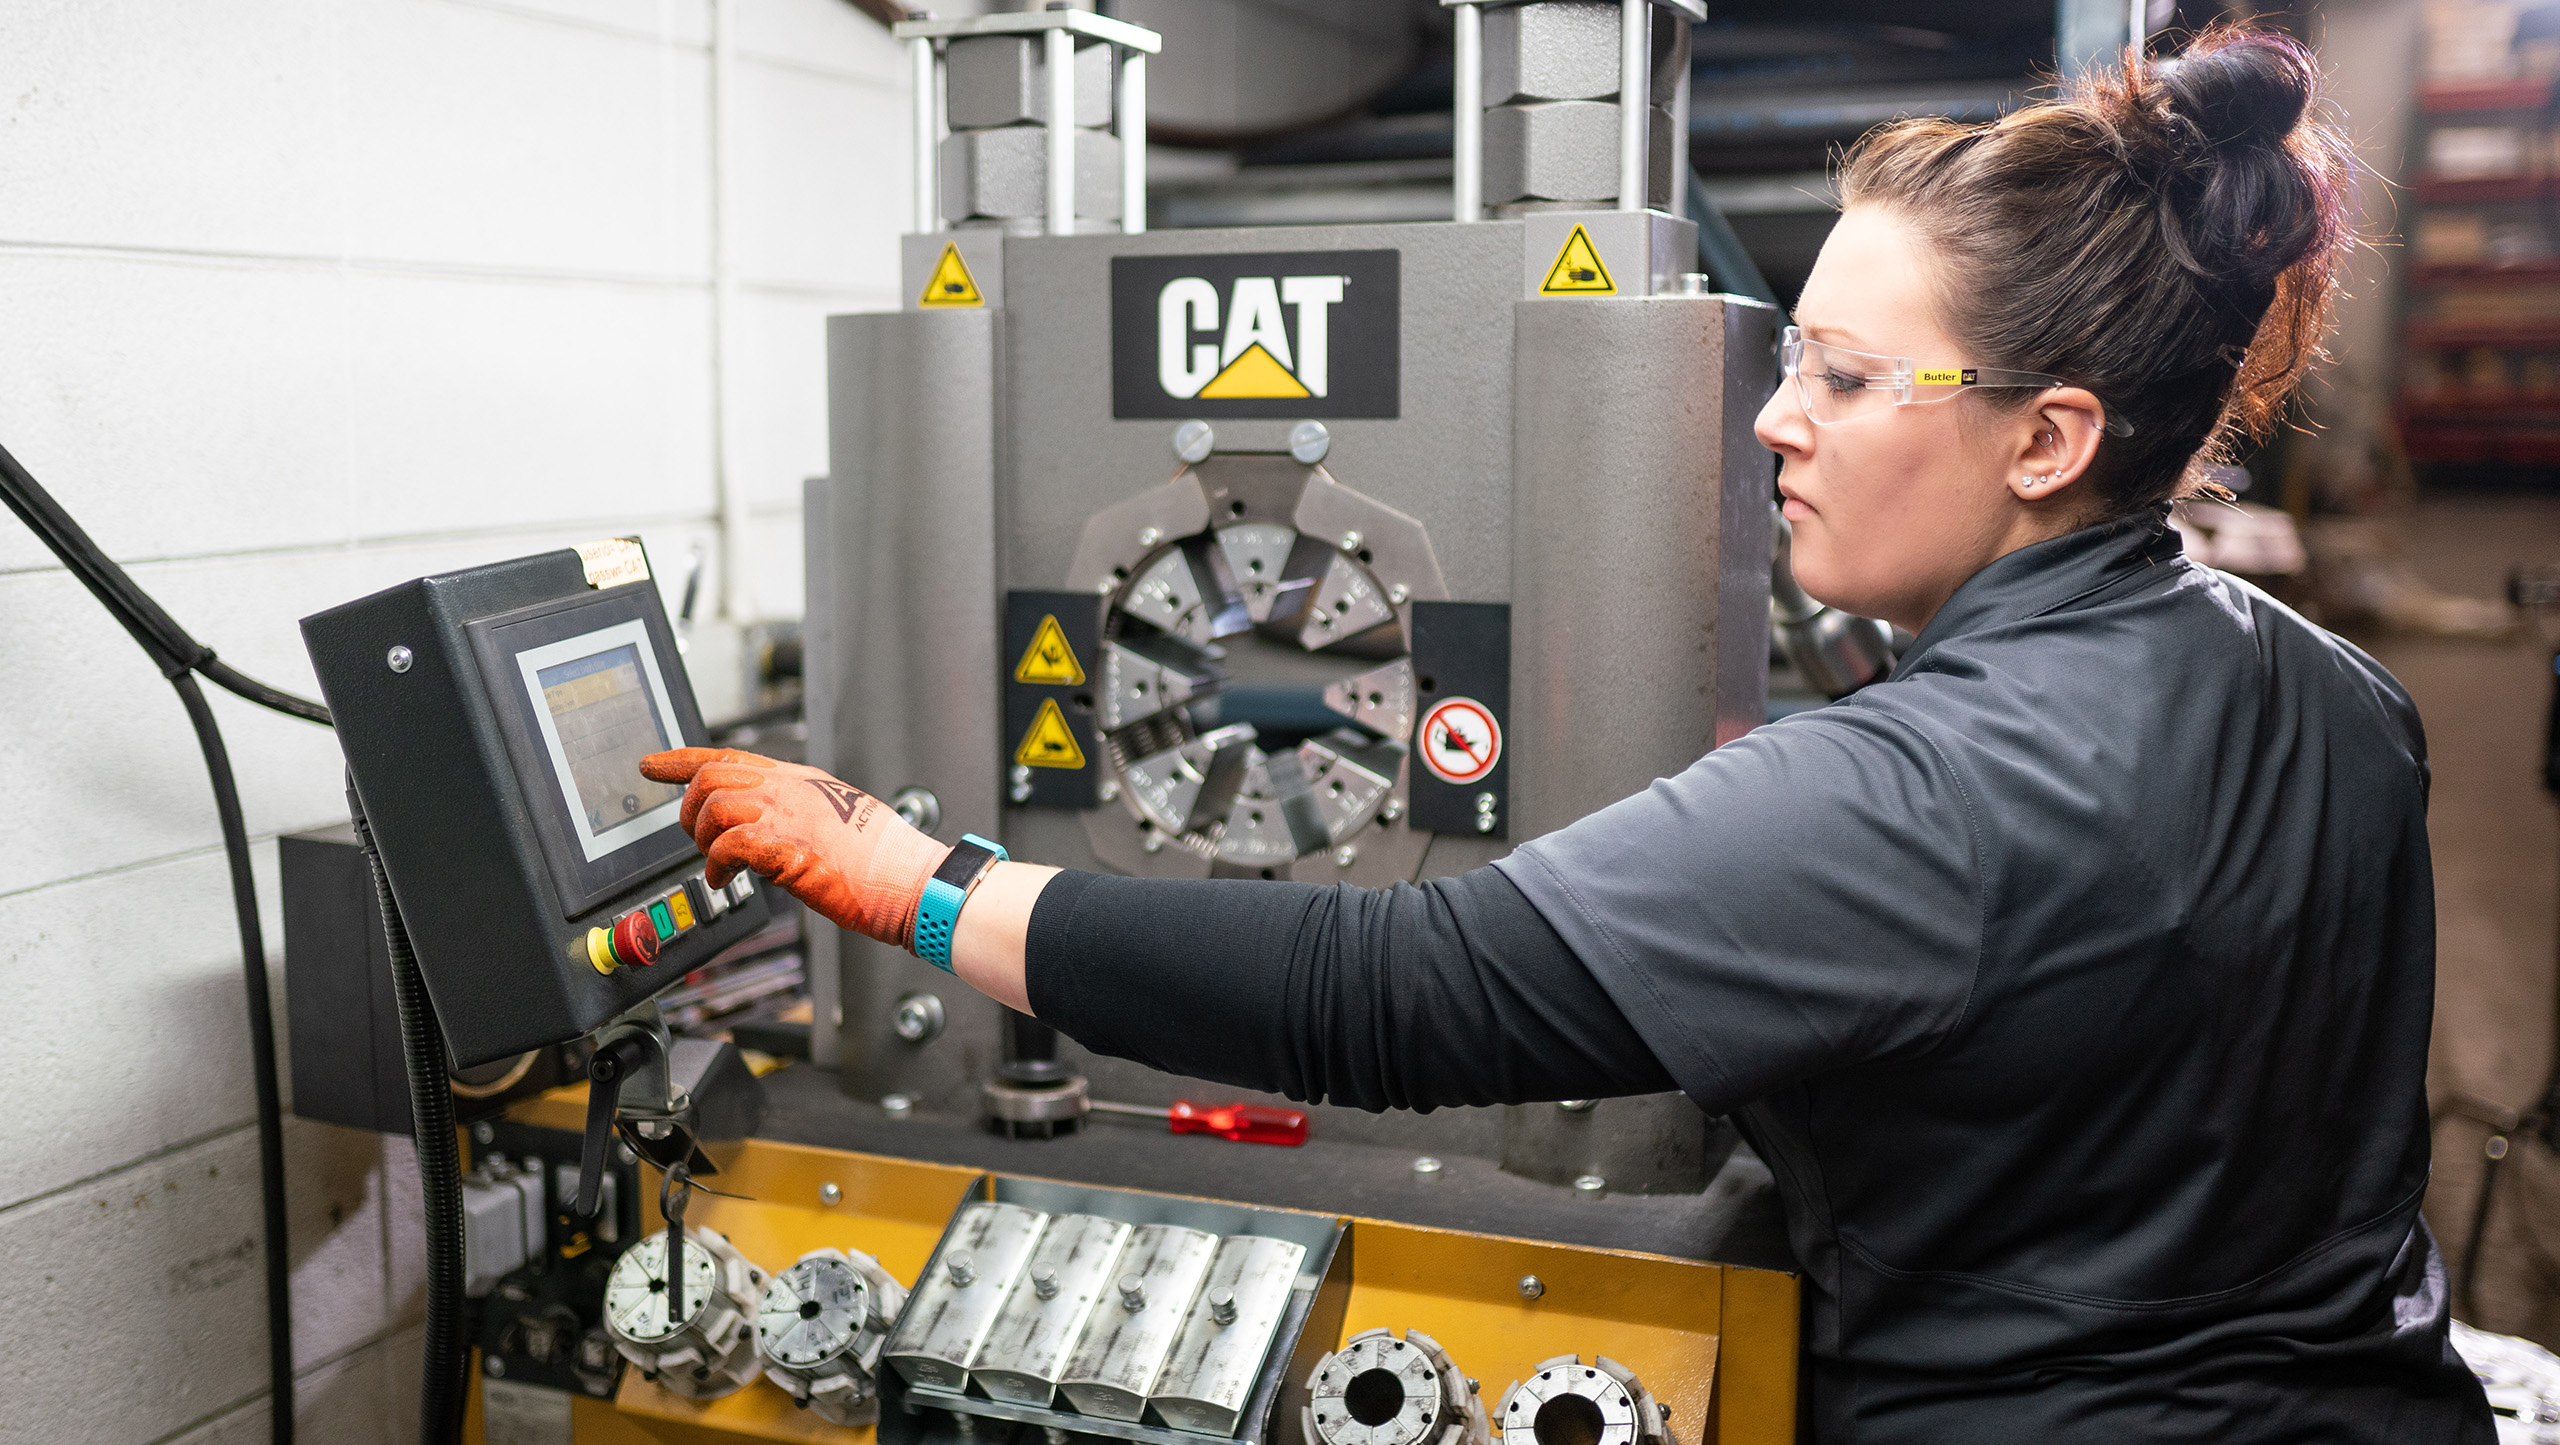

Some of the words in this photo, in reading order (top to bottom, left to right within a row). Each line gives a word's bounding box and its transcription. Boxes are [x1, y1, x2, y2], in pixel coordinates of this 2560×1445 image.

[1158, 275, 1344, 399] CAT
[1924, 373, 1956, 381] Butler
[1962, 373, 1976, 381] CAT
[624, 557, 643, 575] CAT
